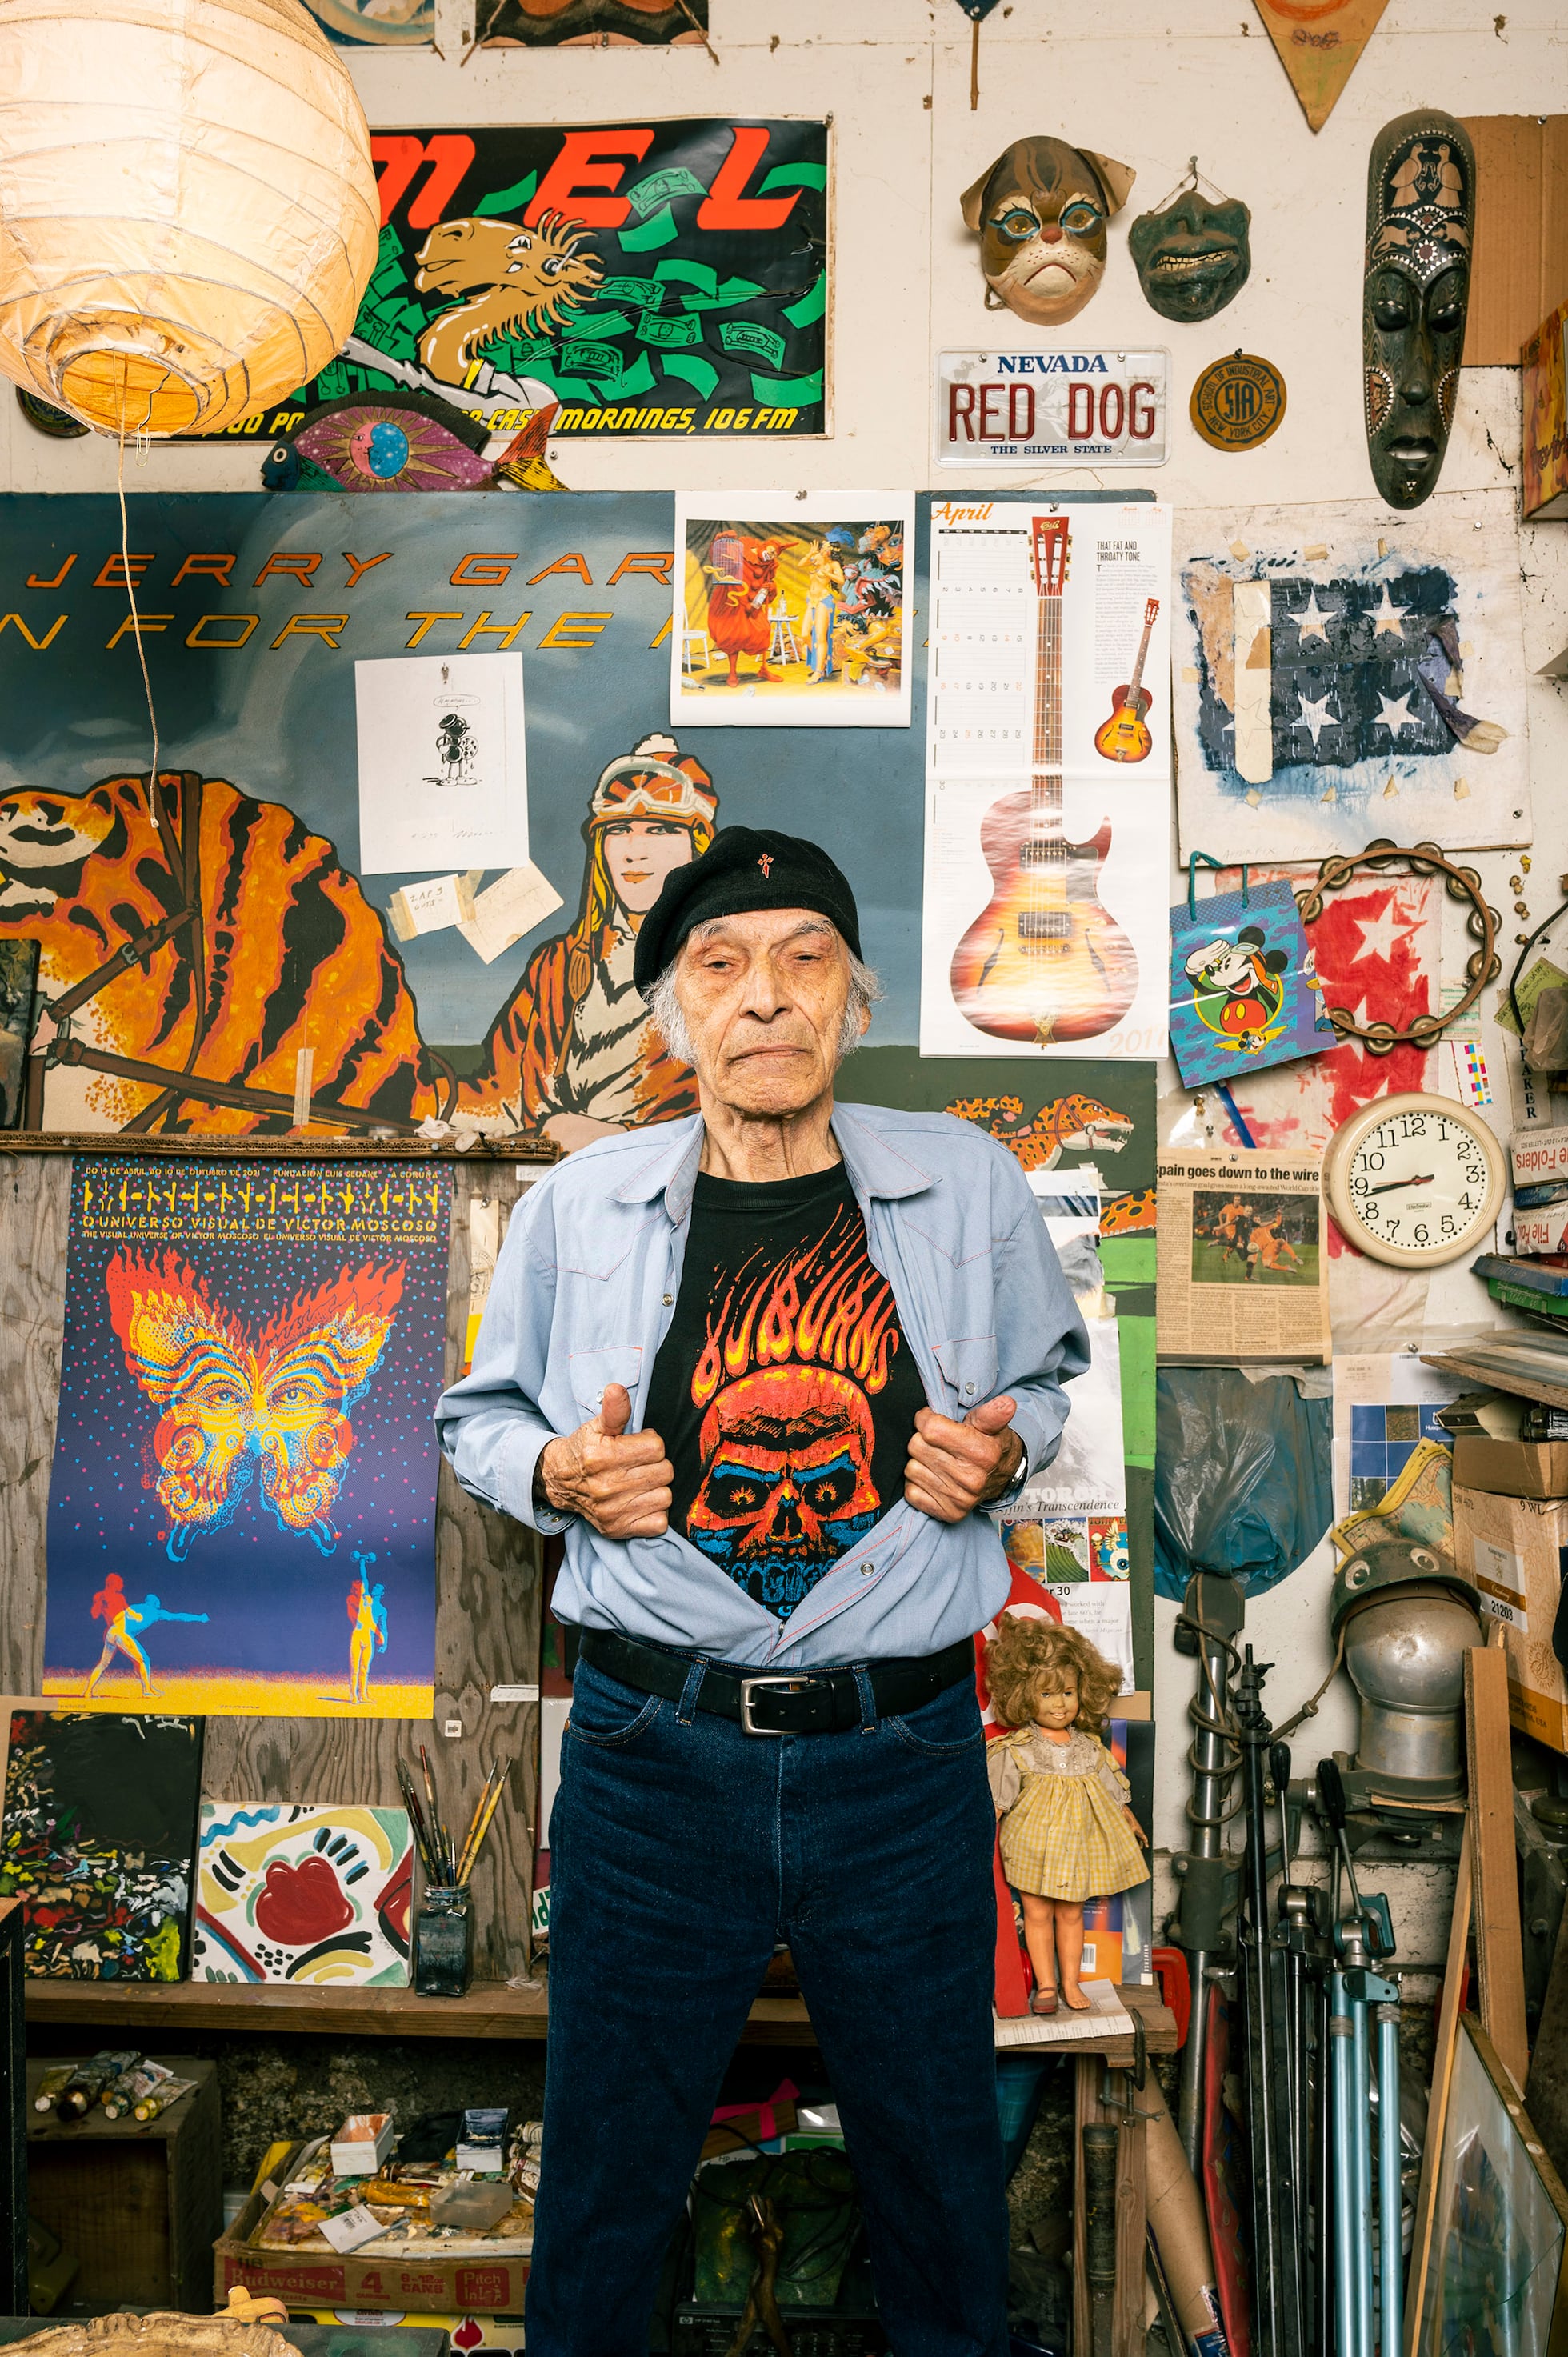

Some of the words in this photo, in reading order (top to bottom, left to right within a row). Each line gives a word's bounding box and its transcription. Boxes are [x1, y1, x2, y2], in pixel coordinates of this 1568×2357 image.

[998, 355, 1109, 374] NEVADA
[1202, 381, 1218, 411] SCHOOL
[1215, 369, 1226, 382] OF
[1226, 364, 1270, 388] INDUSTRIAL
[1264, 389, 1276, 406] ART
[1223, 382, 1254, 421] SIA
[486, 409, 537, 430] CAS
[554, 407, 696, 434] MORNINGS,
[704, 408, 749, 430] 106
[750, 408, 799, 430] FM
[949, 384, 1035, 442] RED
[1068, 383, 1155, 441] DOG
[1208, 416, 1228, 433] NEW
[1230, 425, 1252, 438] YORK
[1251, 411, 1270, 432] CITY
[990, 446, 1018, 454] THE
[1023, 446, 1069, 454] SILVER
[1074, 445, 1112, 454] STATE
[930, 502, 994, 526] April
[1097, 541, 1111, 550] THAT
[1113, 541, 1123, 550] FAT
[1124, 541, 1138, 550] AND
[1097, 552, 1123, 561] THROATY
[1125, 552, 1141, 562] TONE
[26, 552, 394, 588] JERRY
[106, 614, 350, 650] FOR
[404, 612, 614, 650] THE
[1400, 1118, 1426, 1138] 12
[1438, 1123, 1450, 1142] 1
[1377, 1129, 1399, 1149] 11
[1457, 1142, 1471, 1161] 2
[1516, 1148, 1556, 1172] Folders
[1360, 1152, 1385, 1172] 10
[346, 1170, 378, 1178] SEOANE
[1187, 1167, 1216, 1179] goes
[1218, 1166, 1252, 1179] down
[1255, 1167, 1267, 1179] to
[1270, 1168, 1290, 1180] the
[1293, 1169, 1319, 1182] wire
[1466, 1165, 1479, 1183] 3
[1354, 1177, 1369, 1195] 9
[1365, 1202, 1379, 1220] 8
[1458, 1192, 1474, 1211] 4
[82, 1215, 94, 1228] O
[99, 1215, 183, 1229] UNIVERSO
[190, 1217, 250, 1230] VISUAL
[256, 1218, 276, 1231] DE
[284, 1219, 346, 1231] VICTOR
[350, 1219, 438, 1232] MOSCOSO
[1386, 1219, 1400, 1238] 7
[1414, 1223, 1429, 1242] 6
[1441, 1215, 1455, 1233] 5
[82, 1231, 98, 1239] THE
[99, 1231, 128, 1239] VISUAL
[130, 1231, 168, 1239] UNIVERSE
[185, 1232, 215, 1240] VICTOR
[217, 1232, 259, 1240] MOSCOSO
[276, 1233, 316, 1241] UNIVERSO
[318, 1234, 346, 1242] VISUAL
[394, 1235, 437, 1243] MOSCOSO
[1532, 1223, 1550, 1244] File
[1038, 1500, 1120, 1513] Transcendence
[1057, 1587, 1070, 1595] 30
[1490, 1600, 1514, 1622] 21203
[230, 2267, 339, 2291] Budweiser
[361, 2271, 383, 2294] 4
[464, 2271, 502, 2286] Pitch
[401, 2283, 444, 2294] CANS
